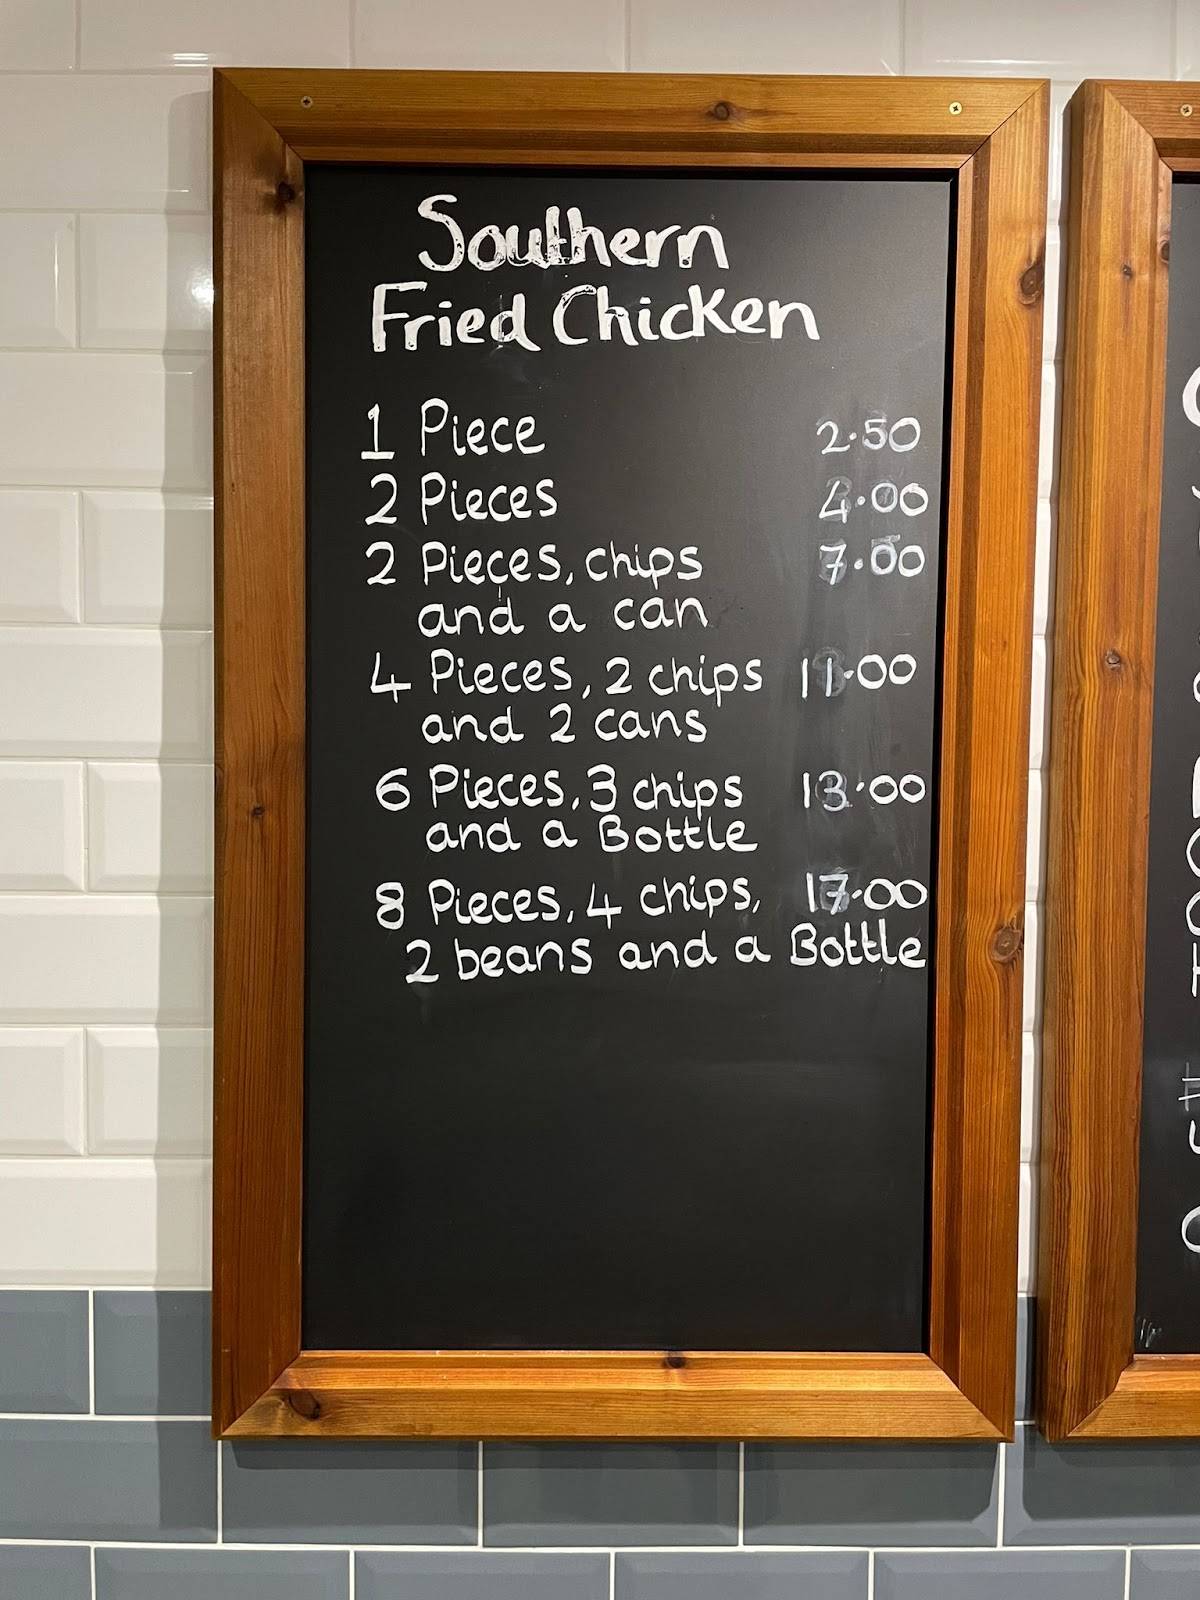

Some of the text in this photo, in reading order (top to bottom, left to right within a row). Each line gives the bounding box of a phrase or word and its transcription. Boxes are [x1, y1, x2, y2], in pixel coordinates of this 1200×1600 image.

[418, 195, 729, 271] Southern
[372, 281, 820, 352] Fried Chicken
[361, 404, 394, 459] 1
[422, 398, 545, 456] Piece
[365, 473, 397, 525] 2
[422, 472, 557, 525] Pieces
[366, 542, 396, 585] 2
[422, 542, 573, 585] Pieces,
[586, 541, 702, 590] chips
[418, 597, 708, 637] and a can
[370, 652, 411, 703] 4
[431, 649, 590, 699] Pieces,
[606, 657, 632, 694] 2
[649, 655, 762, 707] chips
[422, 703, 707, 743] and 2 cans
[376, 768, 410, 811] 6
[430, 764, 579, 810] Pieces,
[587, 764, 617, 812] 3
[633, 771, 742, 821] chips
[426, 815, 758, 852] and a Bottle
[376, 882, 404, 929] 8
[429, 879, 573, 925] Pieces,
[587, 883, 622, 929] 4
[640, 876, 760, 918] chips,
[406, 918, 926, 983] 2 beans and a Bottle
